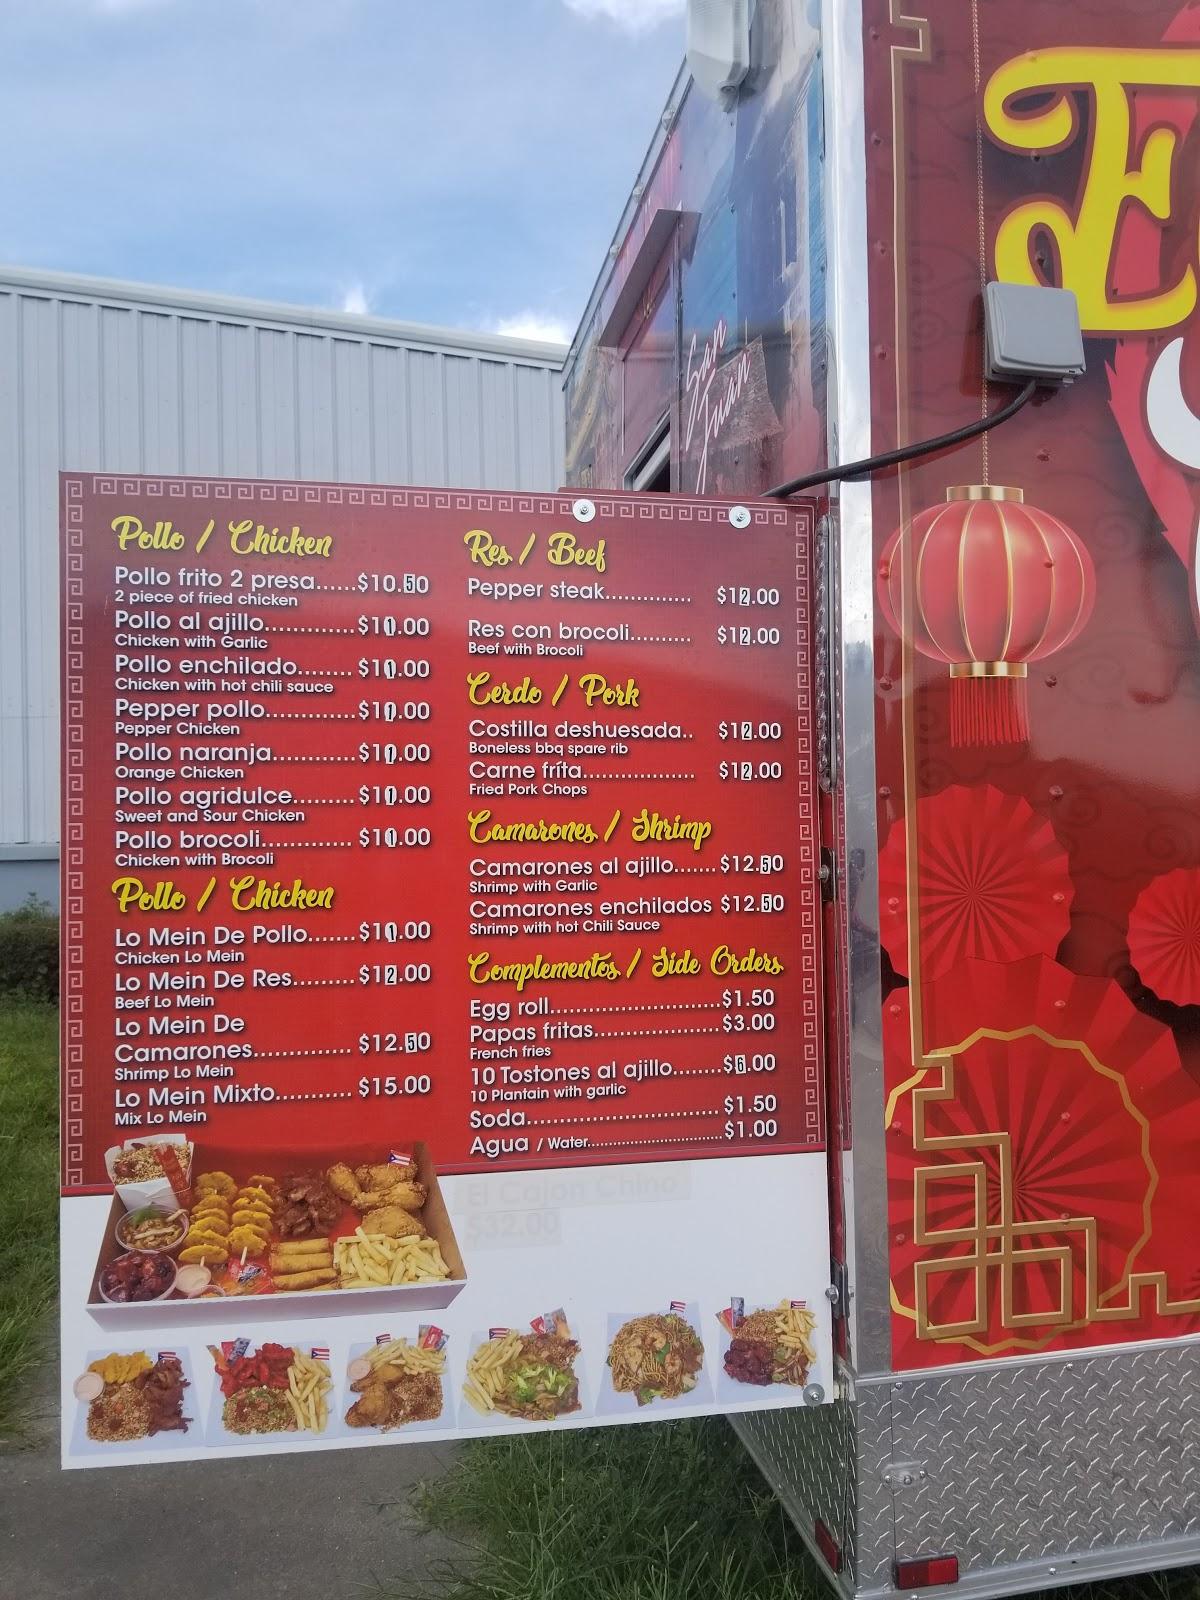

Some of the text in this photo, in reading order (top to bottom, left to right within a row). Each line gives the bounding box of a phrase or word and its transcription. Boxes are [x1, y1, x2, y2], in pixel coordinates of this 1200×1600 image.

[686, 320, 727, 450] San
[111, 516, 332, 557] Pollo Chicken
[464, 530, 605, 572] Res Beef
[116, 566, 428, 593] Pollo frito 2 presa $10.50
[469, 578, 543, 600] Pepper
[550, 581, 604, 599] steak
[115, 590, 297, 606] 2 piece of fried chicken
[116, 610, 263, 634] Pollo al ajillo
[469, 620, 504, 637] Res
[512, 625, 551, 638] con
[560, 622, 628, 640] brocoli
[115, 634, 267, 648] Chicken with Garlic
[469, 642, 583, 655] Beef with Brocoli
[116, 654, 171, 673] Pollo
[179, 656, 297, 675] enchilado
[115, 678, 333, 692] Chicken with hot chili sauce
[467, 672, 639, 707] Cerdo Pork
[116, 699, 264, 721] Pepper pollo
[115, 722, 240, 737] Pepper Chicken
[469, 720, 547, 737] Costilla
[555, 721, 680, 738] deshuesada
[116, 742, 270, 765] Pollo naranja
[470, 742, 628, 756] Boneless bbq spare rib
[115, 766, 243, 781] Orange Chicken
[469, 761, 535, 778] Carne
[116, 787, 292, 809] Pollo agridulce
[470, 783, 587, 797] Fried Pork Chops
[115, 809, 304, 822] Sweet and Sour Chicken
[116, 830, 259, 848] Pollo brocoli
[468, 809, 711, 850] Camarones Shrimp
[115, 852, 273, 866] Chicken with Brocoli
[470, 854, 783, 877] Camarones al ajillo $12.50
[112, 876, 334, 912] Pollo Chicken
[470, 879, 597, 895] Shrimp with Garlic
[470, 894, 784, 918] Camarones enchilados $12.50
[116, 925, 307, 946] Lo Mein De Pollo
[470, 919, 660, 936] Shrimp with hot Chili Sauce
[115, 949, 244, 964] Chicken Lo Mein
[468, 945, 784, 991] Complementos Side Orders
[116, 973, 140, 991] Lo
[149, 971, 205, 990] Mein
[214, 971, 244, 988] De
[253, 969, 291, 987] Res
[115, 994, 214, 1009] Beef Lo Mein
[471, 989, 774, 1021] Egg roll $1.50
[116, 1014, 244, 1036] Lo Mein De
[471, 1013, 774, 1045] Papas fritas $3.00
[115, 1032, 430, 1062] Camarones $12.50
[470, 1045, 551, 1059] French fries
[115, 1064, 233, 1082] Shrimp Lo Mein
[472, 1067, 495, 1085] 10
[500, 1065, 590, 1083] Tostones
[598, 1061, 616, 1079] al
[624, 1059, 672, 1081] ajillo
[116, 1075, 430, 1107] Lo Mein Mixto $15.00
[471, 1083, 626, 1102] 10 Plantain with garlic
[115, 1110, 206, 1125] Mix Lo Mein
[470, 1095, 776, 1128] Soda $1.50
[470, 1119, 777, 1157] Agua Water $1.00
